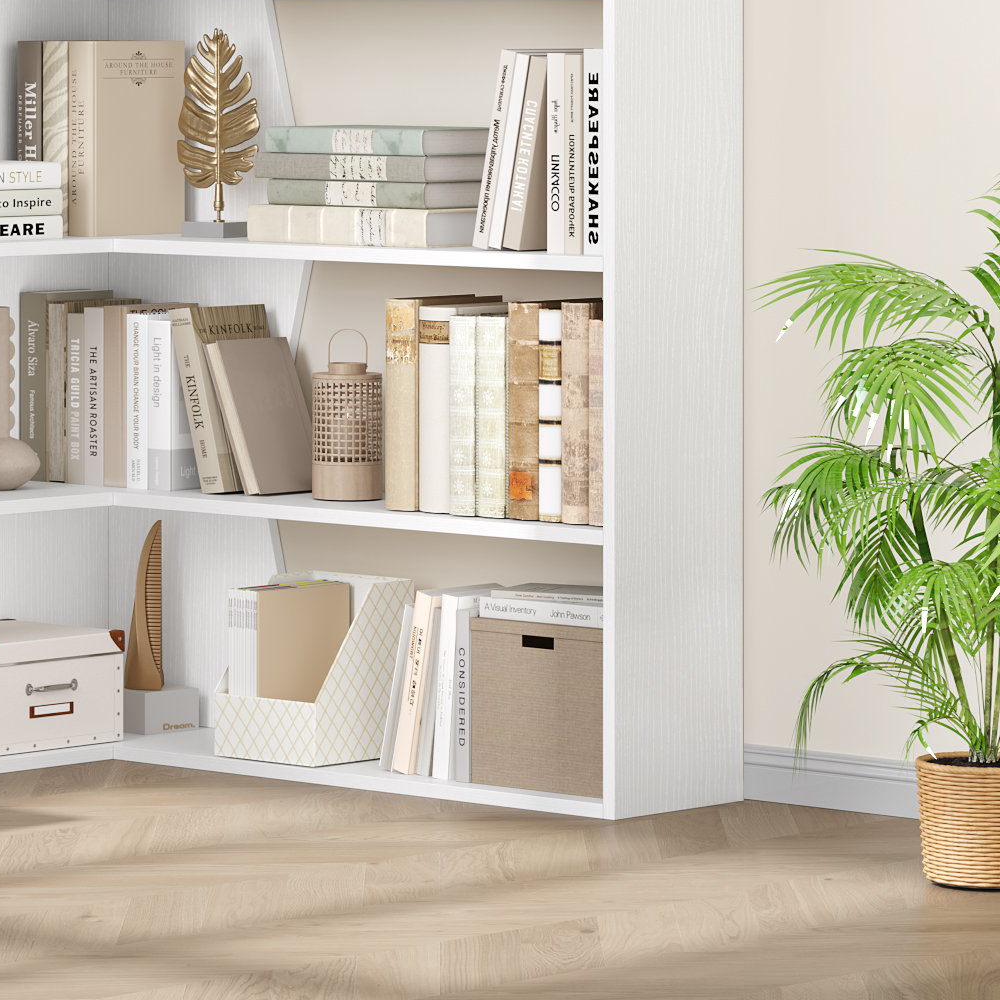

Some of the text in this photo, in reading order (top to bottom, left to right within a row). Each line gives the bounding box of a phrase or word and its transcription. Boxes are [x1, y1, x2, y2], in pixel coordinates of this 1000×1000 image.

[25, 82, 36, 140] Miller
[9, 171, 42, 184] STYLE
[12, 197, 52, 210] Inspire
[27, 320, 39, 376] Álvaro Siza
[209, 323, 253, 335] KINFOLK
[70, 338, 80, 460] TRICIA GUILD PAINT BOX
[152, 337, 162, 408] Light in design
[89, 347, 97, 457] THE ARTISAN ROASTER
[186, 376, 204, 429] KINFOLK
[180, 466, 196, 478] Light
[490, 604, 508, 612] Visual
[509, 606, 536, 615] Inventory
[550, 610, 565, 618] John
[566, 612, 590, 621] Pawson
[458, 647, 466, 747] CONSIDERED
